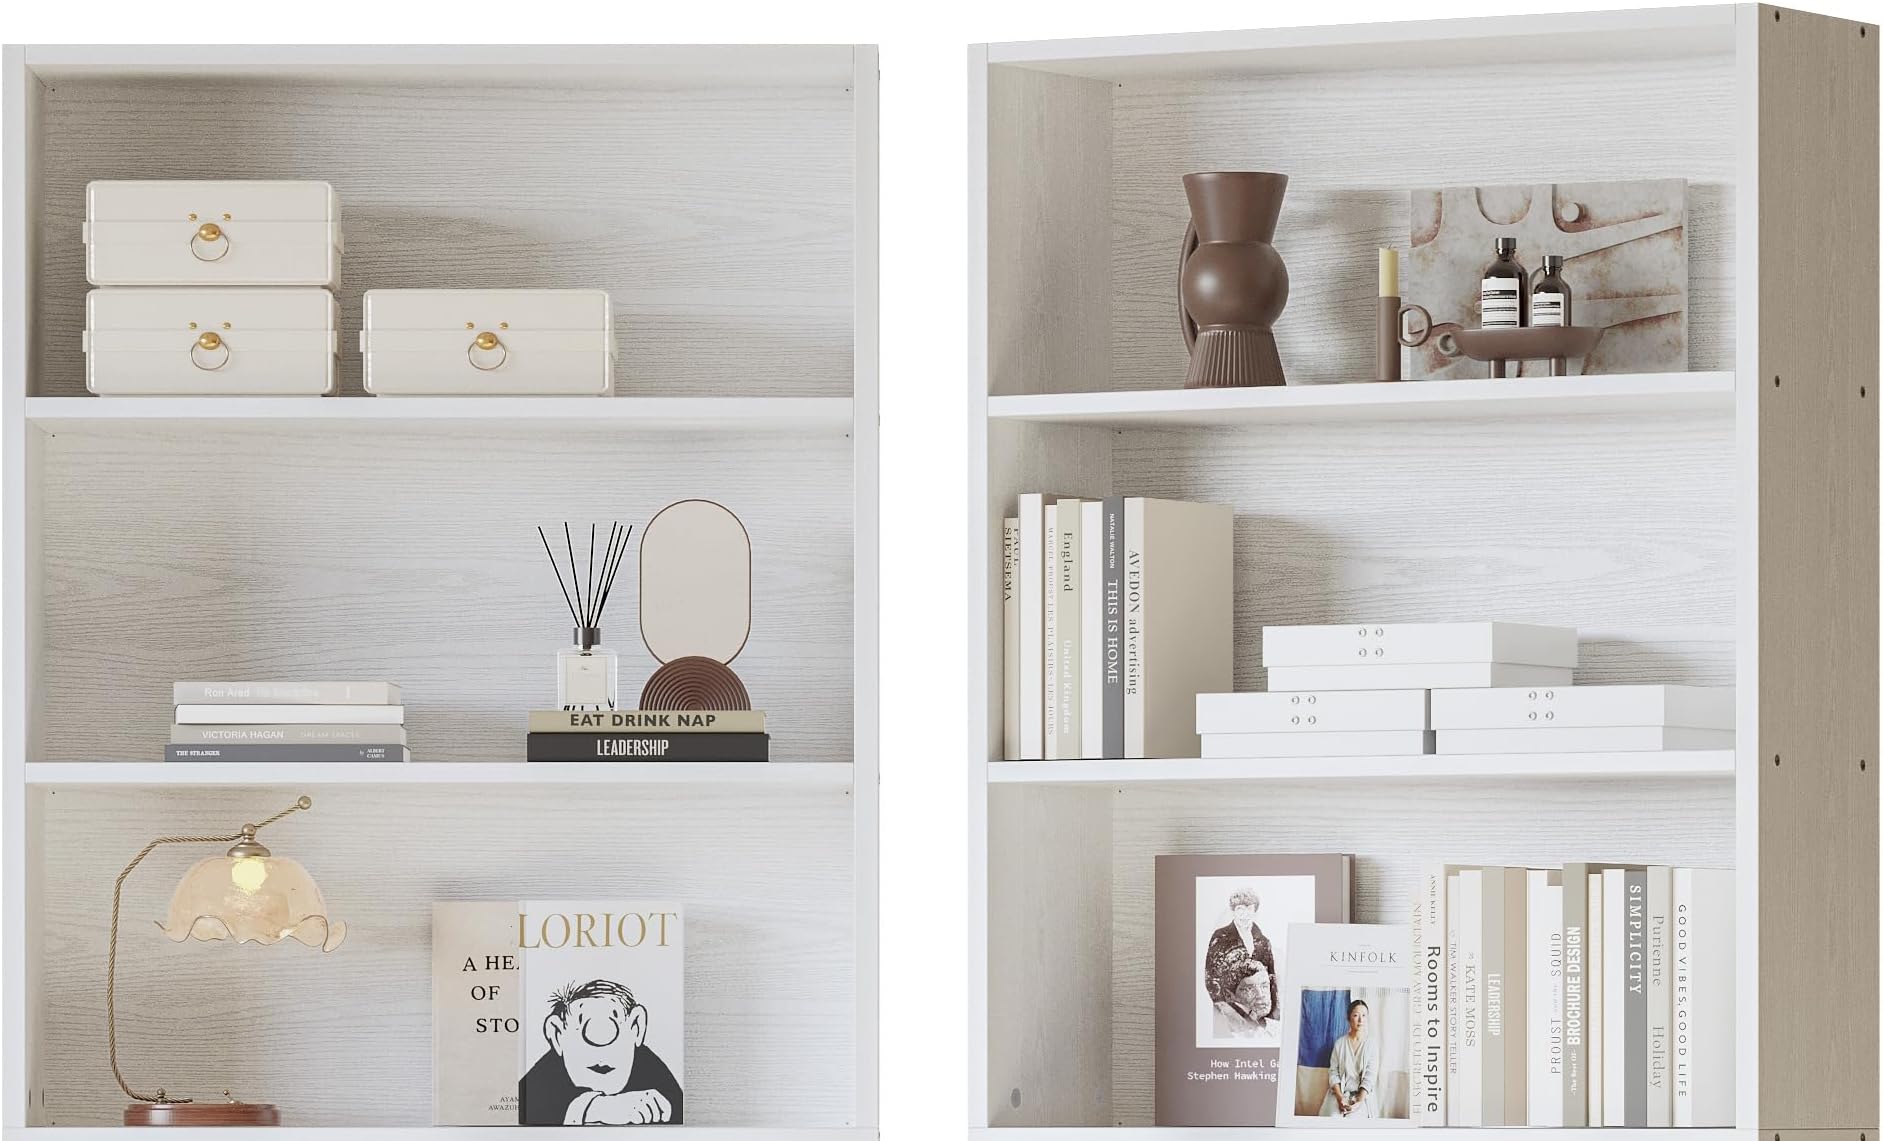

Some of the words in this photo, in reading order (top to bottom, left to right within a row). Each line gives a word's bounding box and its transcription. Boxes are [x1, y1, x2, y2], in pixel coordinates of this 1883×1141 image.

[1004, 527, 1012, 601] SIETSEMA
[1061, 532, 1073, 591] England
[1128, 550, 1140, 613] AVEDON
[1107, 579, 1118, 615] THIS
[1107, 619, 1118, 633] IS
[1107, 637, 1118, 684] HOME
[1126, 618, 1140, 695] advertising
[202, 731, 248, 739] VICTORIA
[250, 731, 283, 739] HAGAN
[570, 714, 604, 727] EAT
[612, 714, 671, 727] DRINK
[678, 714, 716, 727] NAP
[597, 739, 669, 756] LEADERSHIP
[519, 912, 677, 949] LORIOT
[1630, 885, 1642, 995] SIMPLICITY
[1678, 904, 1687, 950] GOOD
[462, 957, 477, 972] A
[485, 955, 519, 970] HE
[1330, 951, 1397, 963] KINFOLK
[1551, 933, 1561, 977] SQUID
[1567, 927, 1581, 974] DESIGN
[1652, 915, 1665, 986] Purienne
[471, 985, 501, 1000] OF
[1427, 946, 1441, 1012] Rooms
[1465, 965, 1475, 1003] KATE
[1487, 973, 1501, 1036] LEADERSHIP
[1567, 976, 1581, 1045] BROCHURE
[476, 1018, 519, 1033] STO
[1427, 1019, 1441, 1038] to
[1465, 1008, 1475, 1047] MOSS
[1551, 1018, 1561, 1074] PROUST
[1187, 1072, 1229, 1082] Stephen
[1234, 1072, 1277, 1082] Hawking
[1210, 1059, 1229, 1068] How
[1235, 1059, 1264, 1068] Intel
[1650, 1026, 1665, 1089] Holiday
[1424, 1046, 1442, 1113] Inspire
[1678, 1064, 1687, 1097] LIFE
